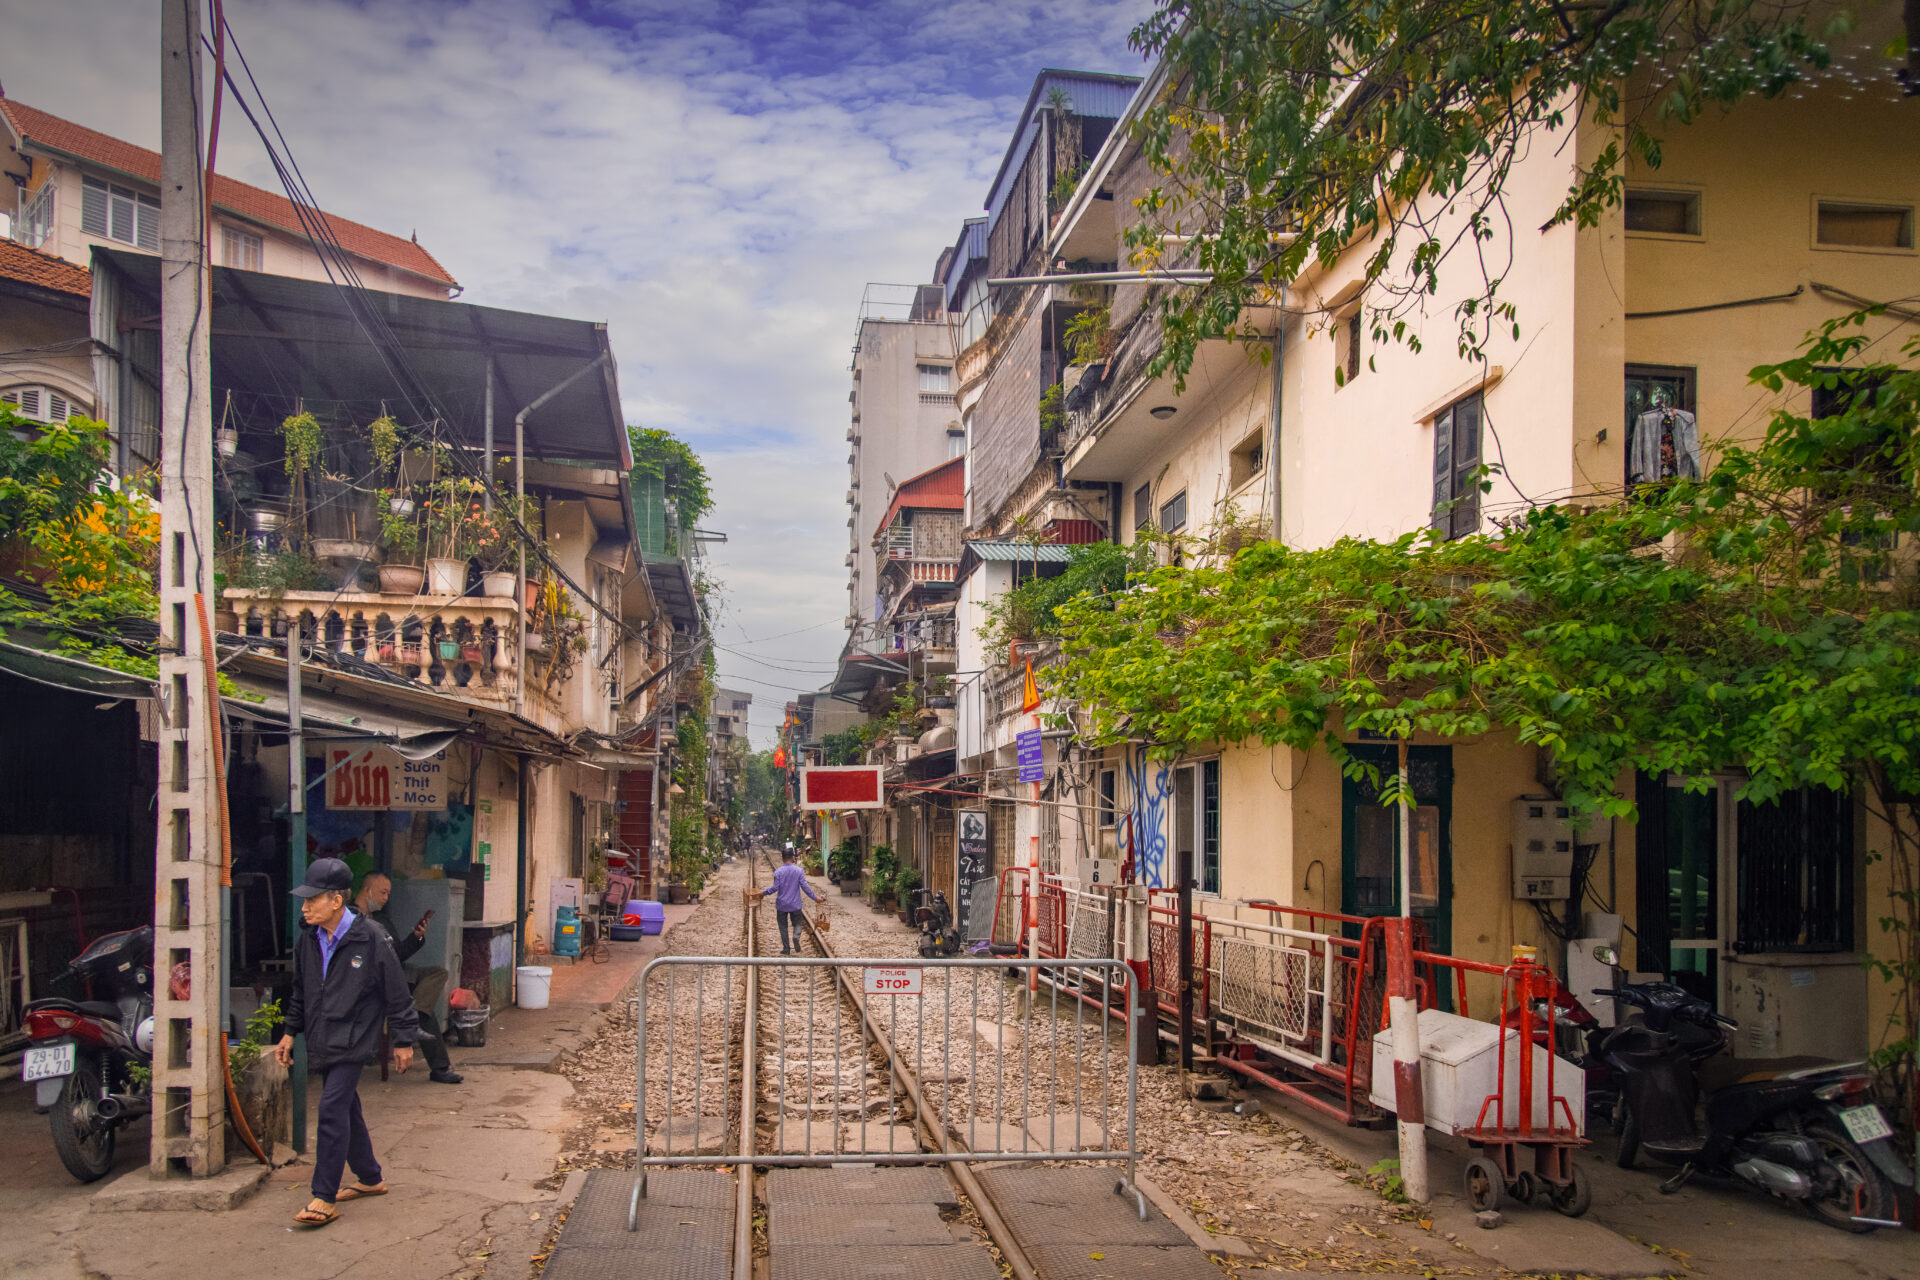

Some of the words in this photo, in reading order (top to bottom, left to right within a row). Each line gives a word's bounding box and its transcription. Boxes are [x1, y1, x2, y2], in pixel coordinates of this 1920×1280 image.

[403, 761, 441, 773] Sườn
[333, 750, 391, 806] Bún
[403, 776, 430, 791] Thịt
[403, 791, 437, 806] Mọc
[880, 969, 907, 977] POLICE
[875, 979, 911, 989] STOP
[27, 1059, 71, 1079] 644.70
